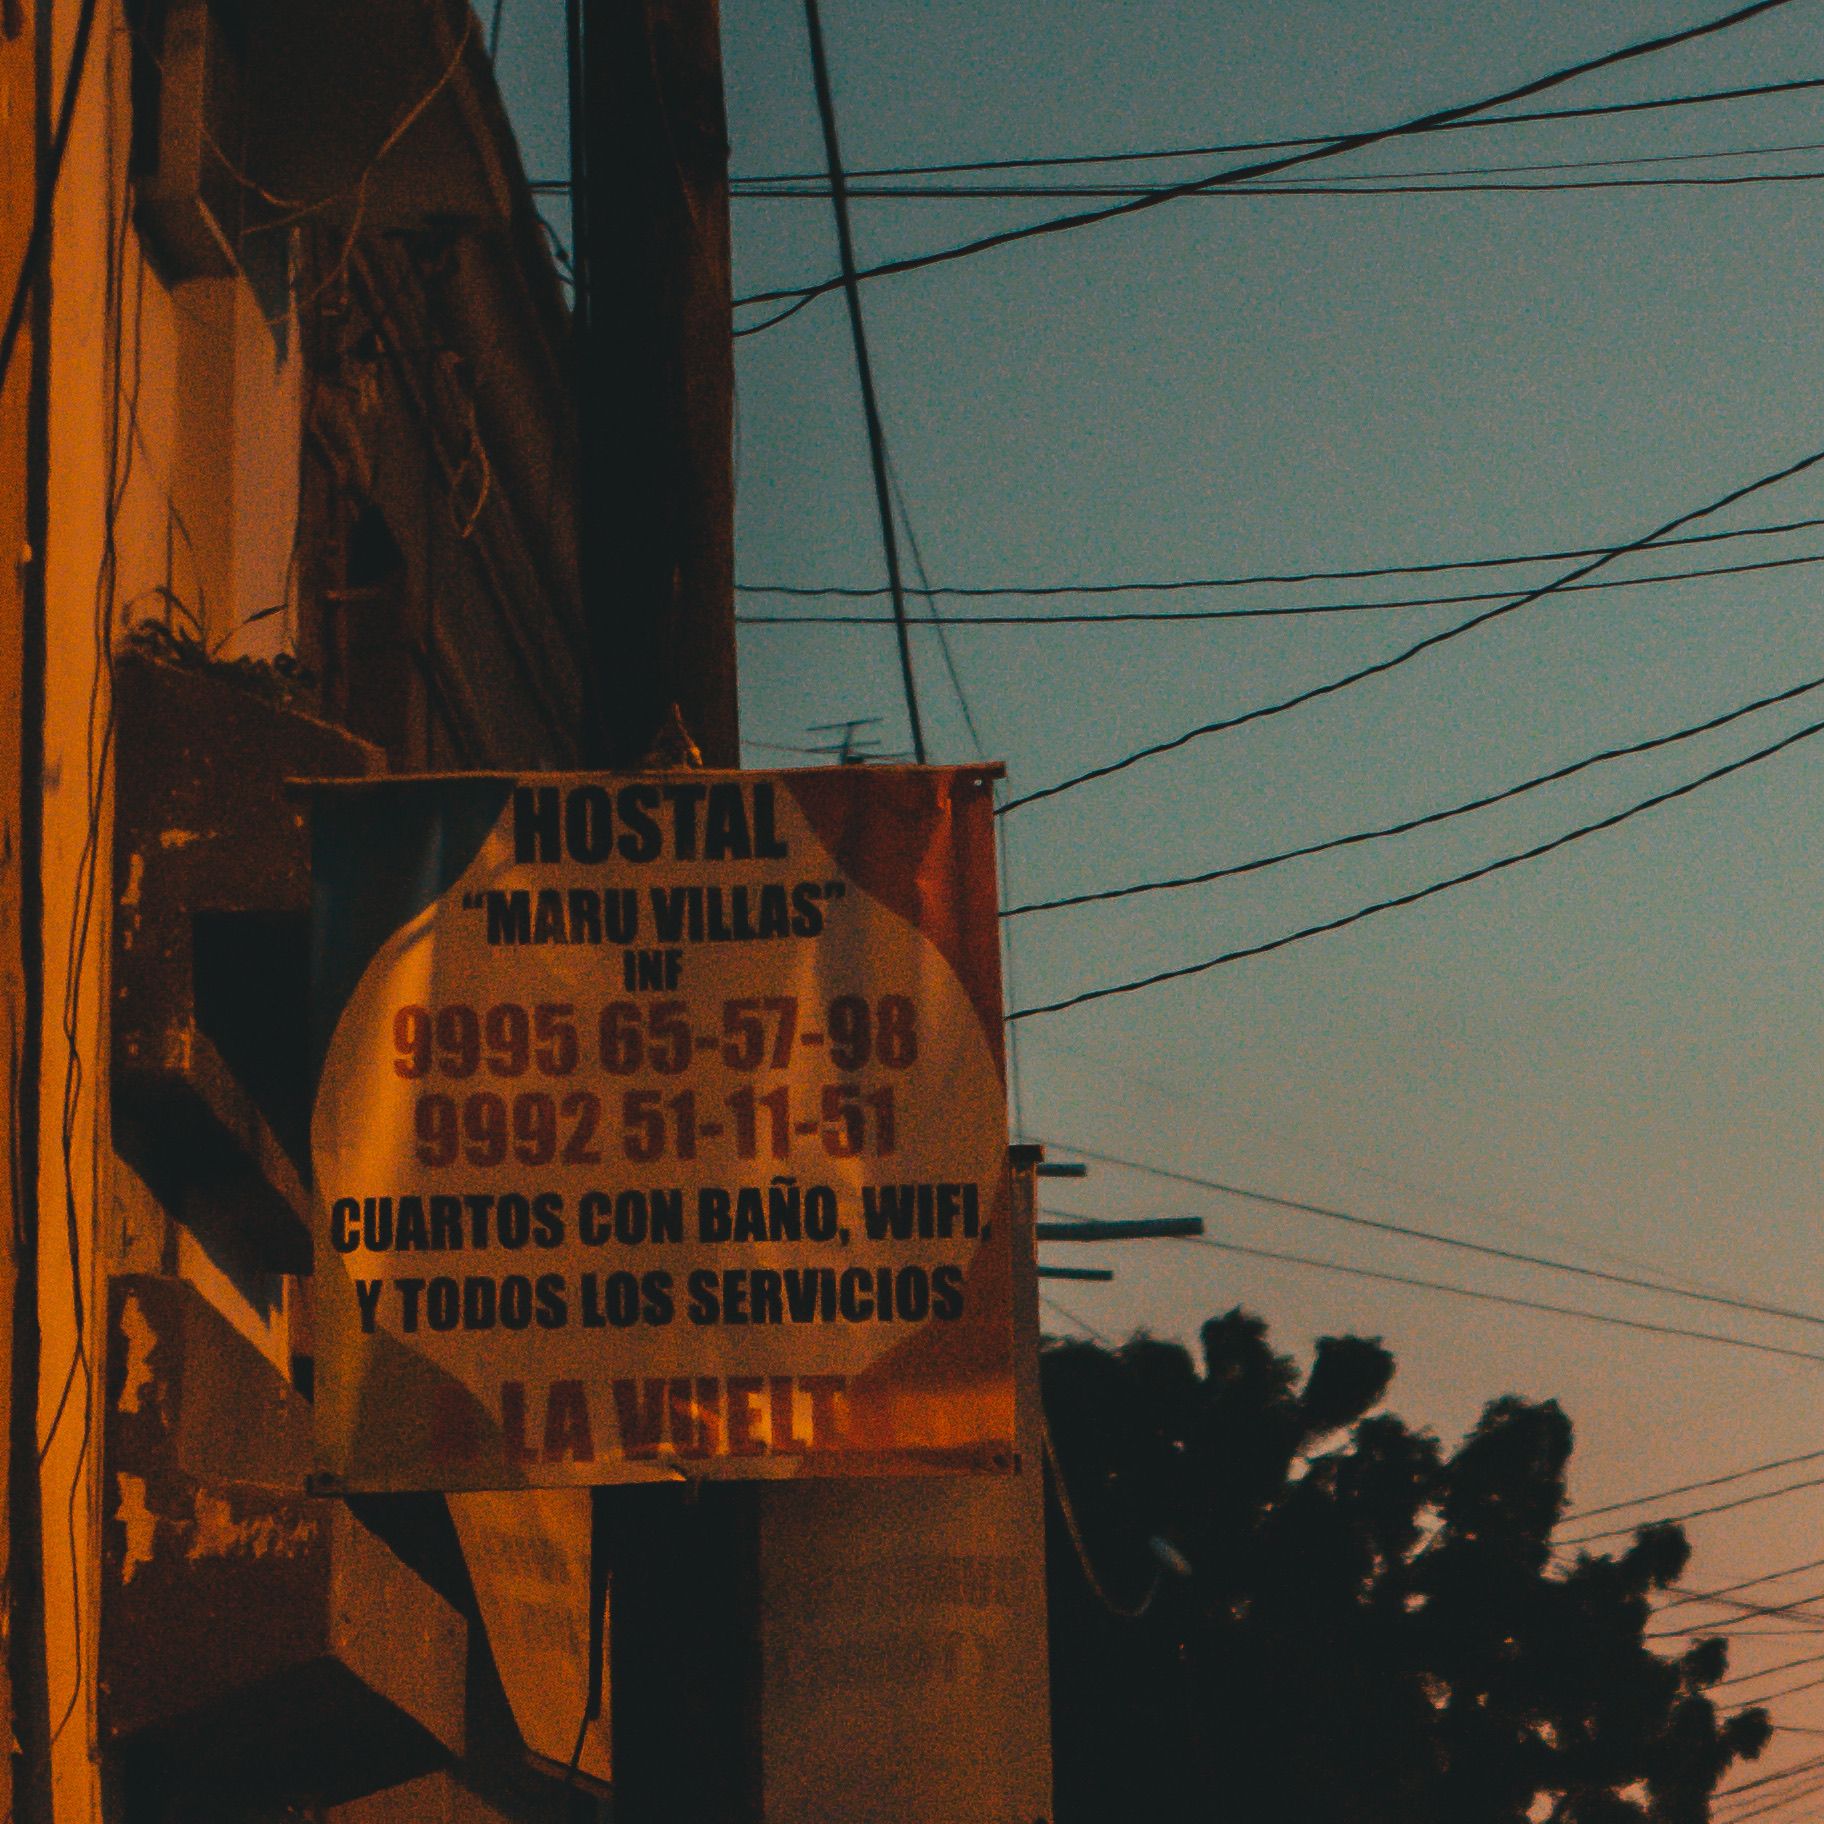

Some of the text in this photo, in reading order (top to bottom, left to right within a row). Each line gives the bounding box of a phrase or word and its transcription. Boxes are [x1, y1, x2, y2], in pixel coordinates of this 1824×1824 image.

[513, 781, 788, 865] HOSTAL
[623, 949, 683, 993] INF
[393, 994, 919, 1080] 9995 65-57-98
[414, 1084, 897, 1169] 9992 51-11-51
[331, 1176, 992, 1254] CUARTOS CON BAÑO, WIFI,
[356, 1264, 965, 1334] Y TODOS LOS SERVICIOS
[500, 1379, 594, 1464] LA
